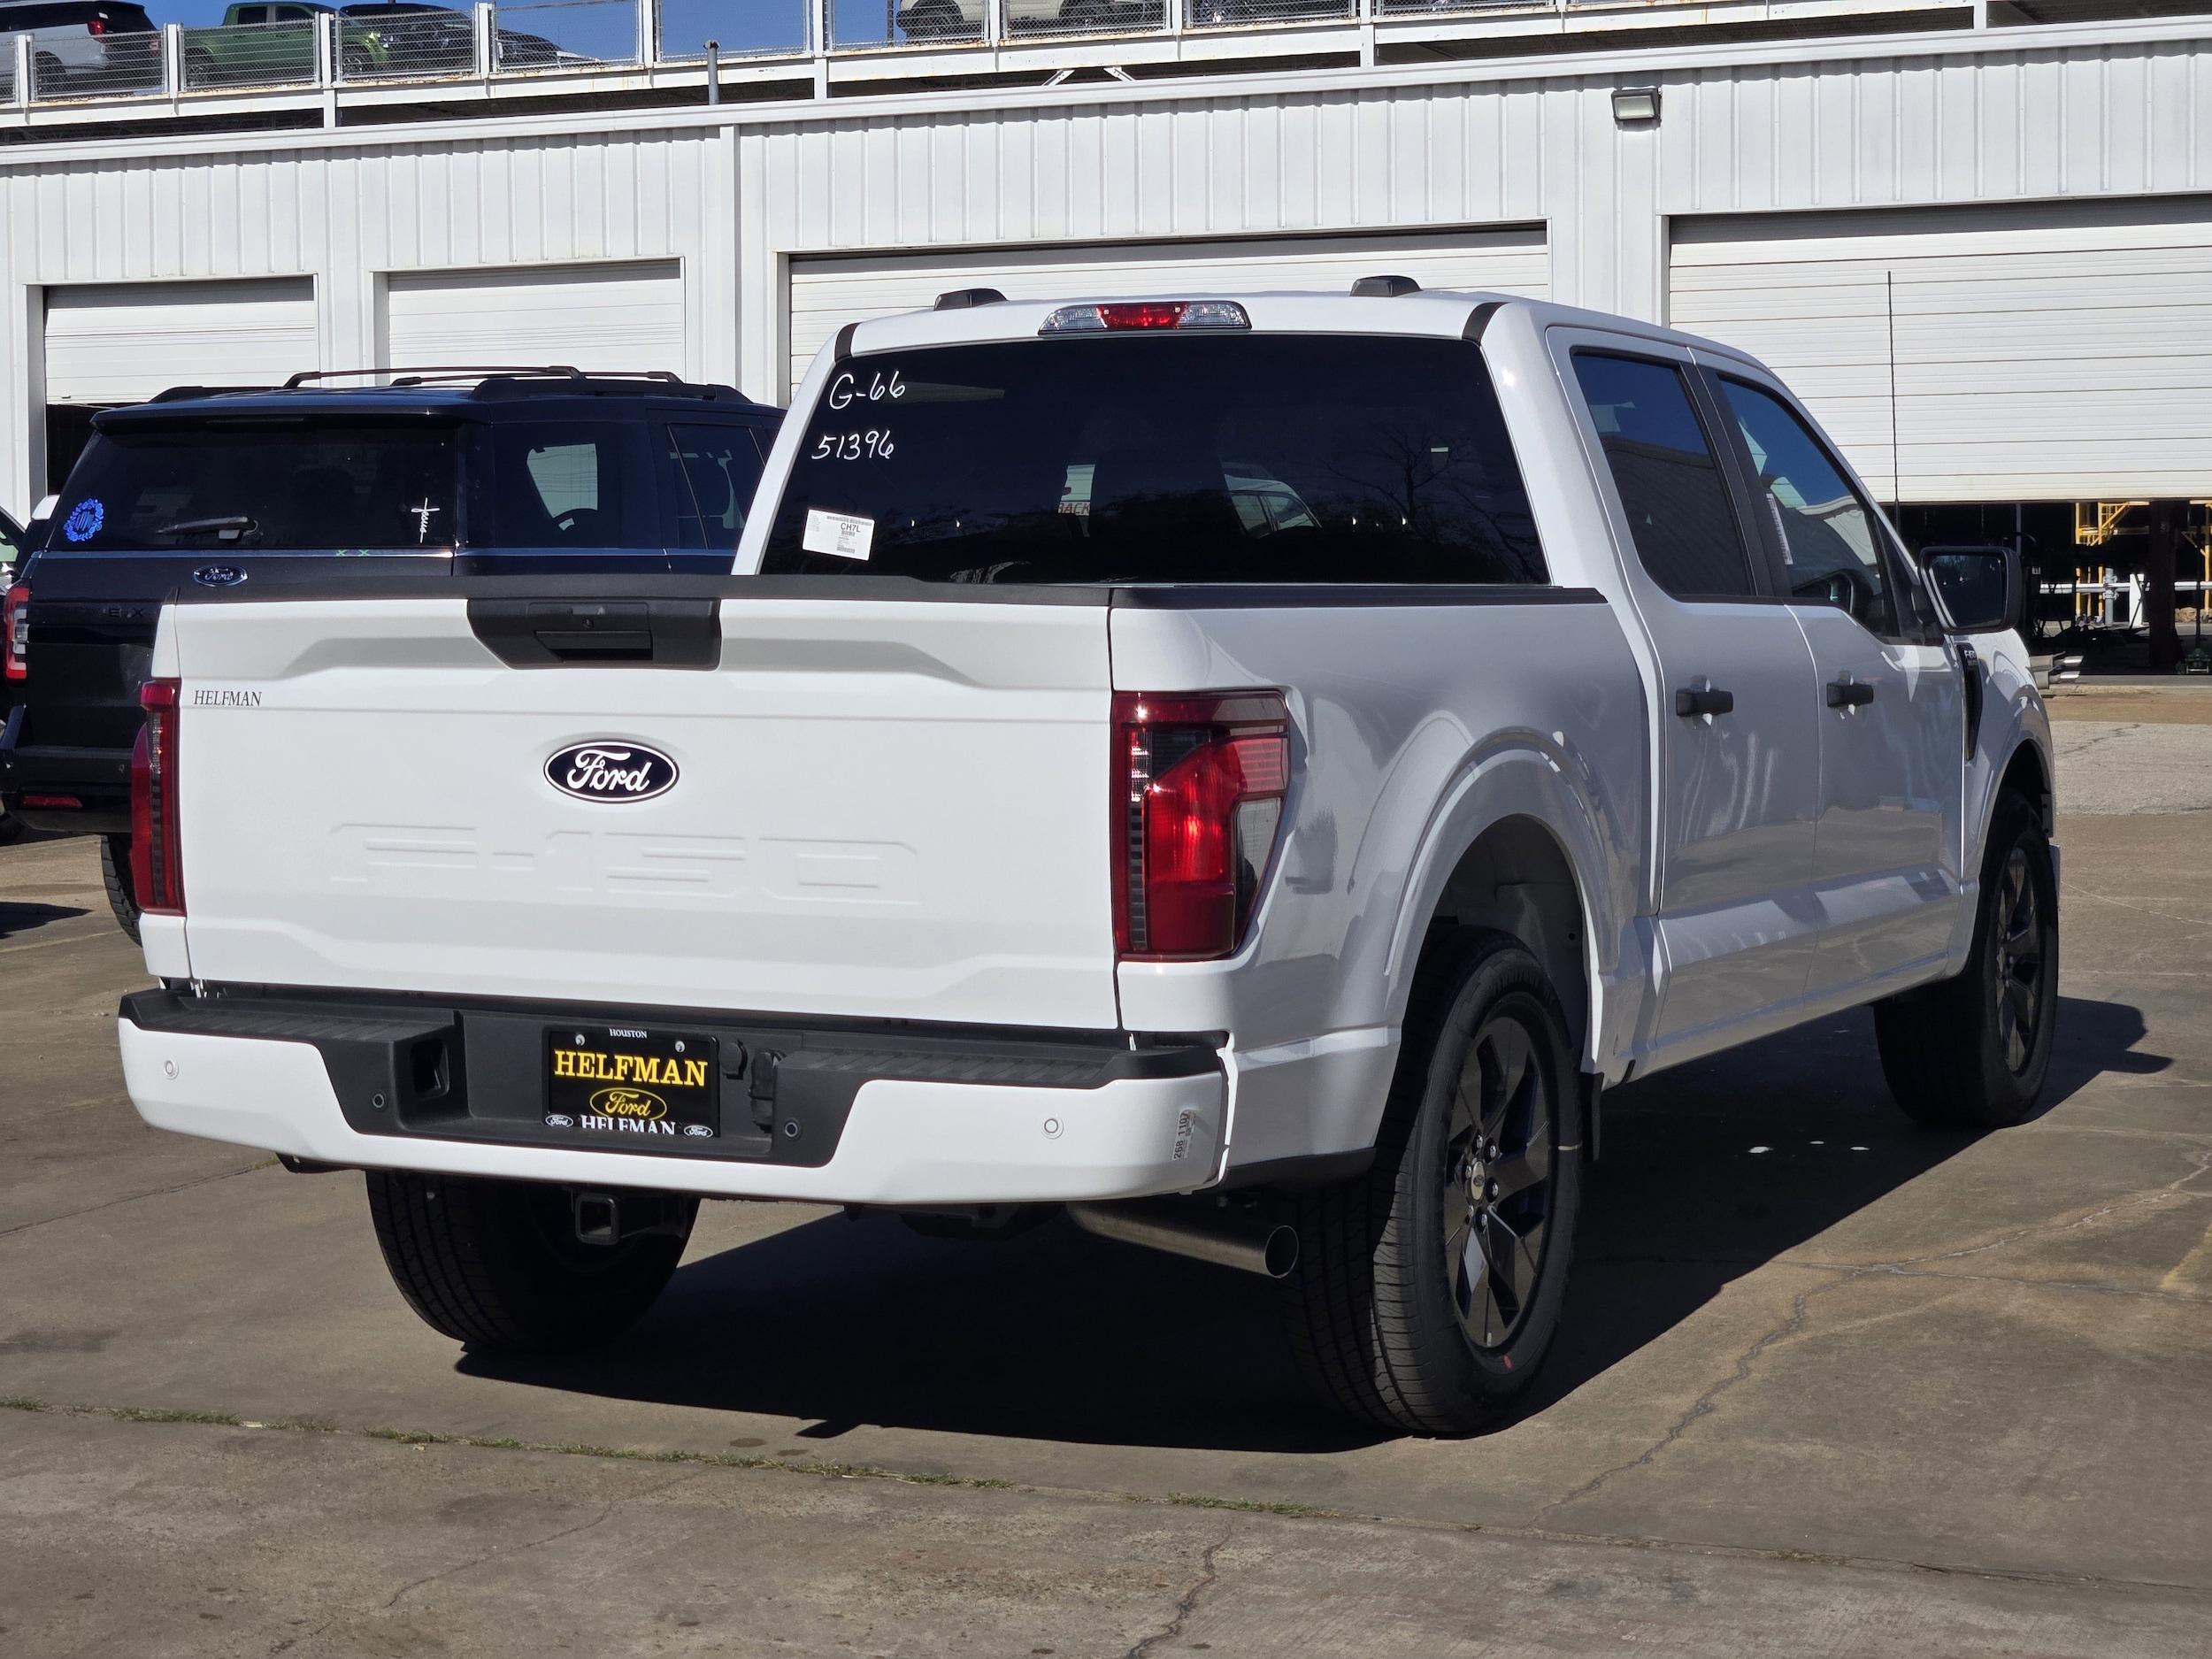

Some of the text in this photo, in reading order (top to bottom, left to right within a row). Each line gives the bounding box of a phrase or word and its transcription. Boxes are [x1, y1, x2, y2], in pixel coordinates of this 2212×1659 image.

[829, 370, 906, 410] G-66
[811, 429, 895, 460] 51396
[840, 522, 861, 533] CH7L
[194, 689, 262, 707] HELFMAN
[567, 749, 652, 792] Ford
[609, 1028, 648, 1040] HOUSTON
[554, 1049, 708, 1087] HELFMAN
[605, 1091, 651, 1117] Ford
[1173, 1112, 1189, 1159] 268 1107
